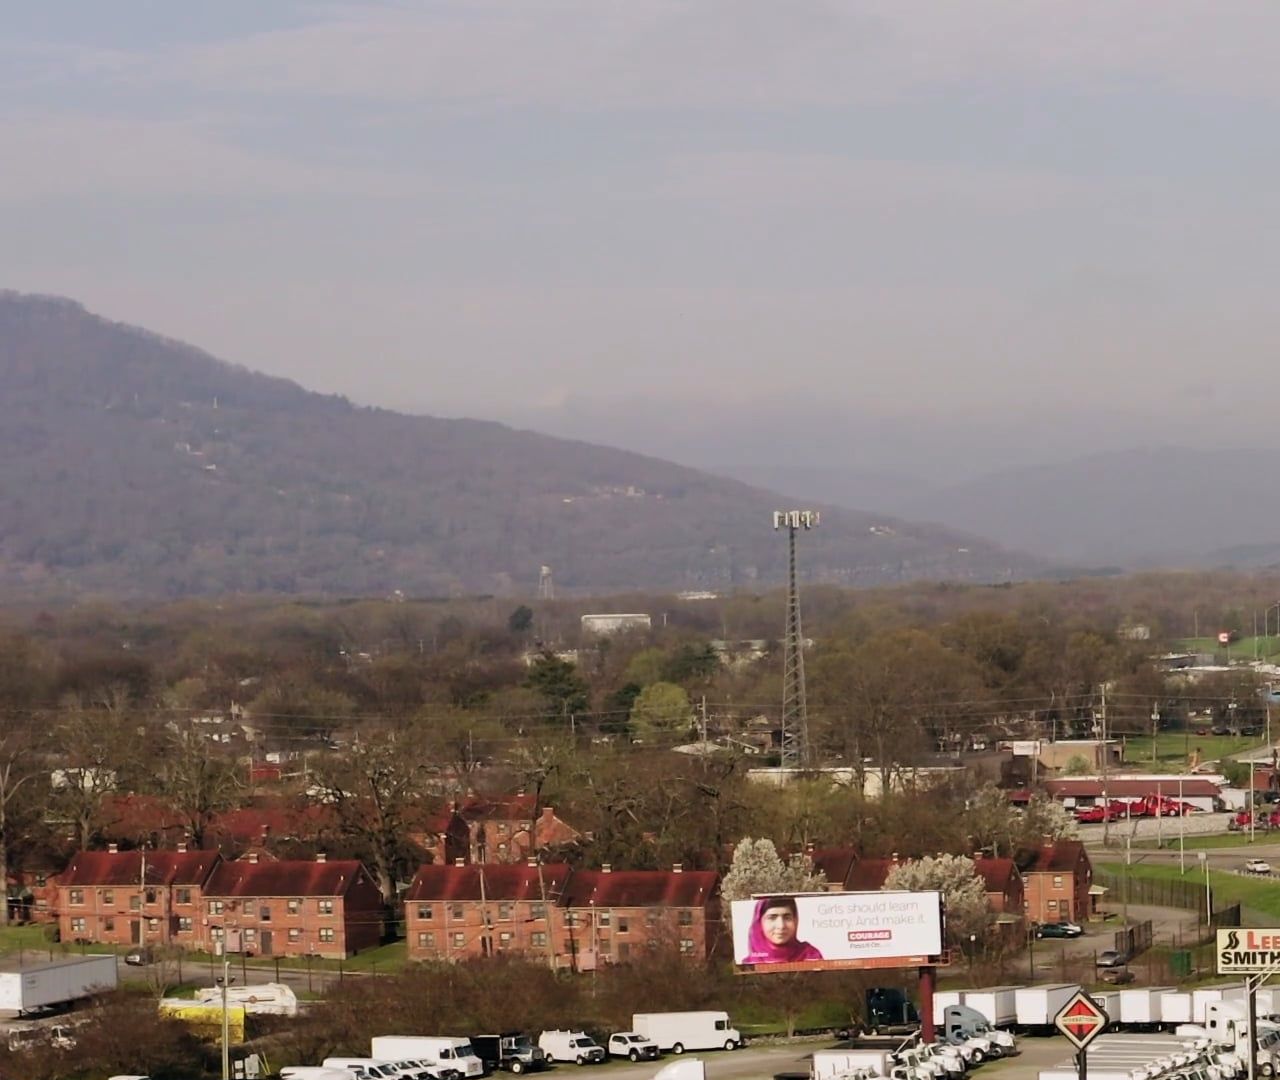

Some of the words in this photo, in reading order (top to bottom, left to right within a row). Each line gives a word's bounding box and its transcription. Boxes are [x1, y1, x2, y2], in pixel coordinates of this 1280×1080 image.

[817, 903, 845, 916] Girls
[846, 901, 887, 914] should
[888, 900, 919, 912] learn
[811, 917, 855, 929] history.
[856, 914, 880, 927] And
[881, 914, 913, 926] make
[850, 932, 890, 941] COURAGE
